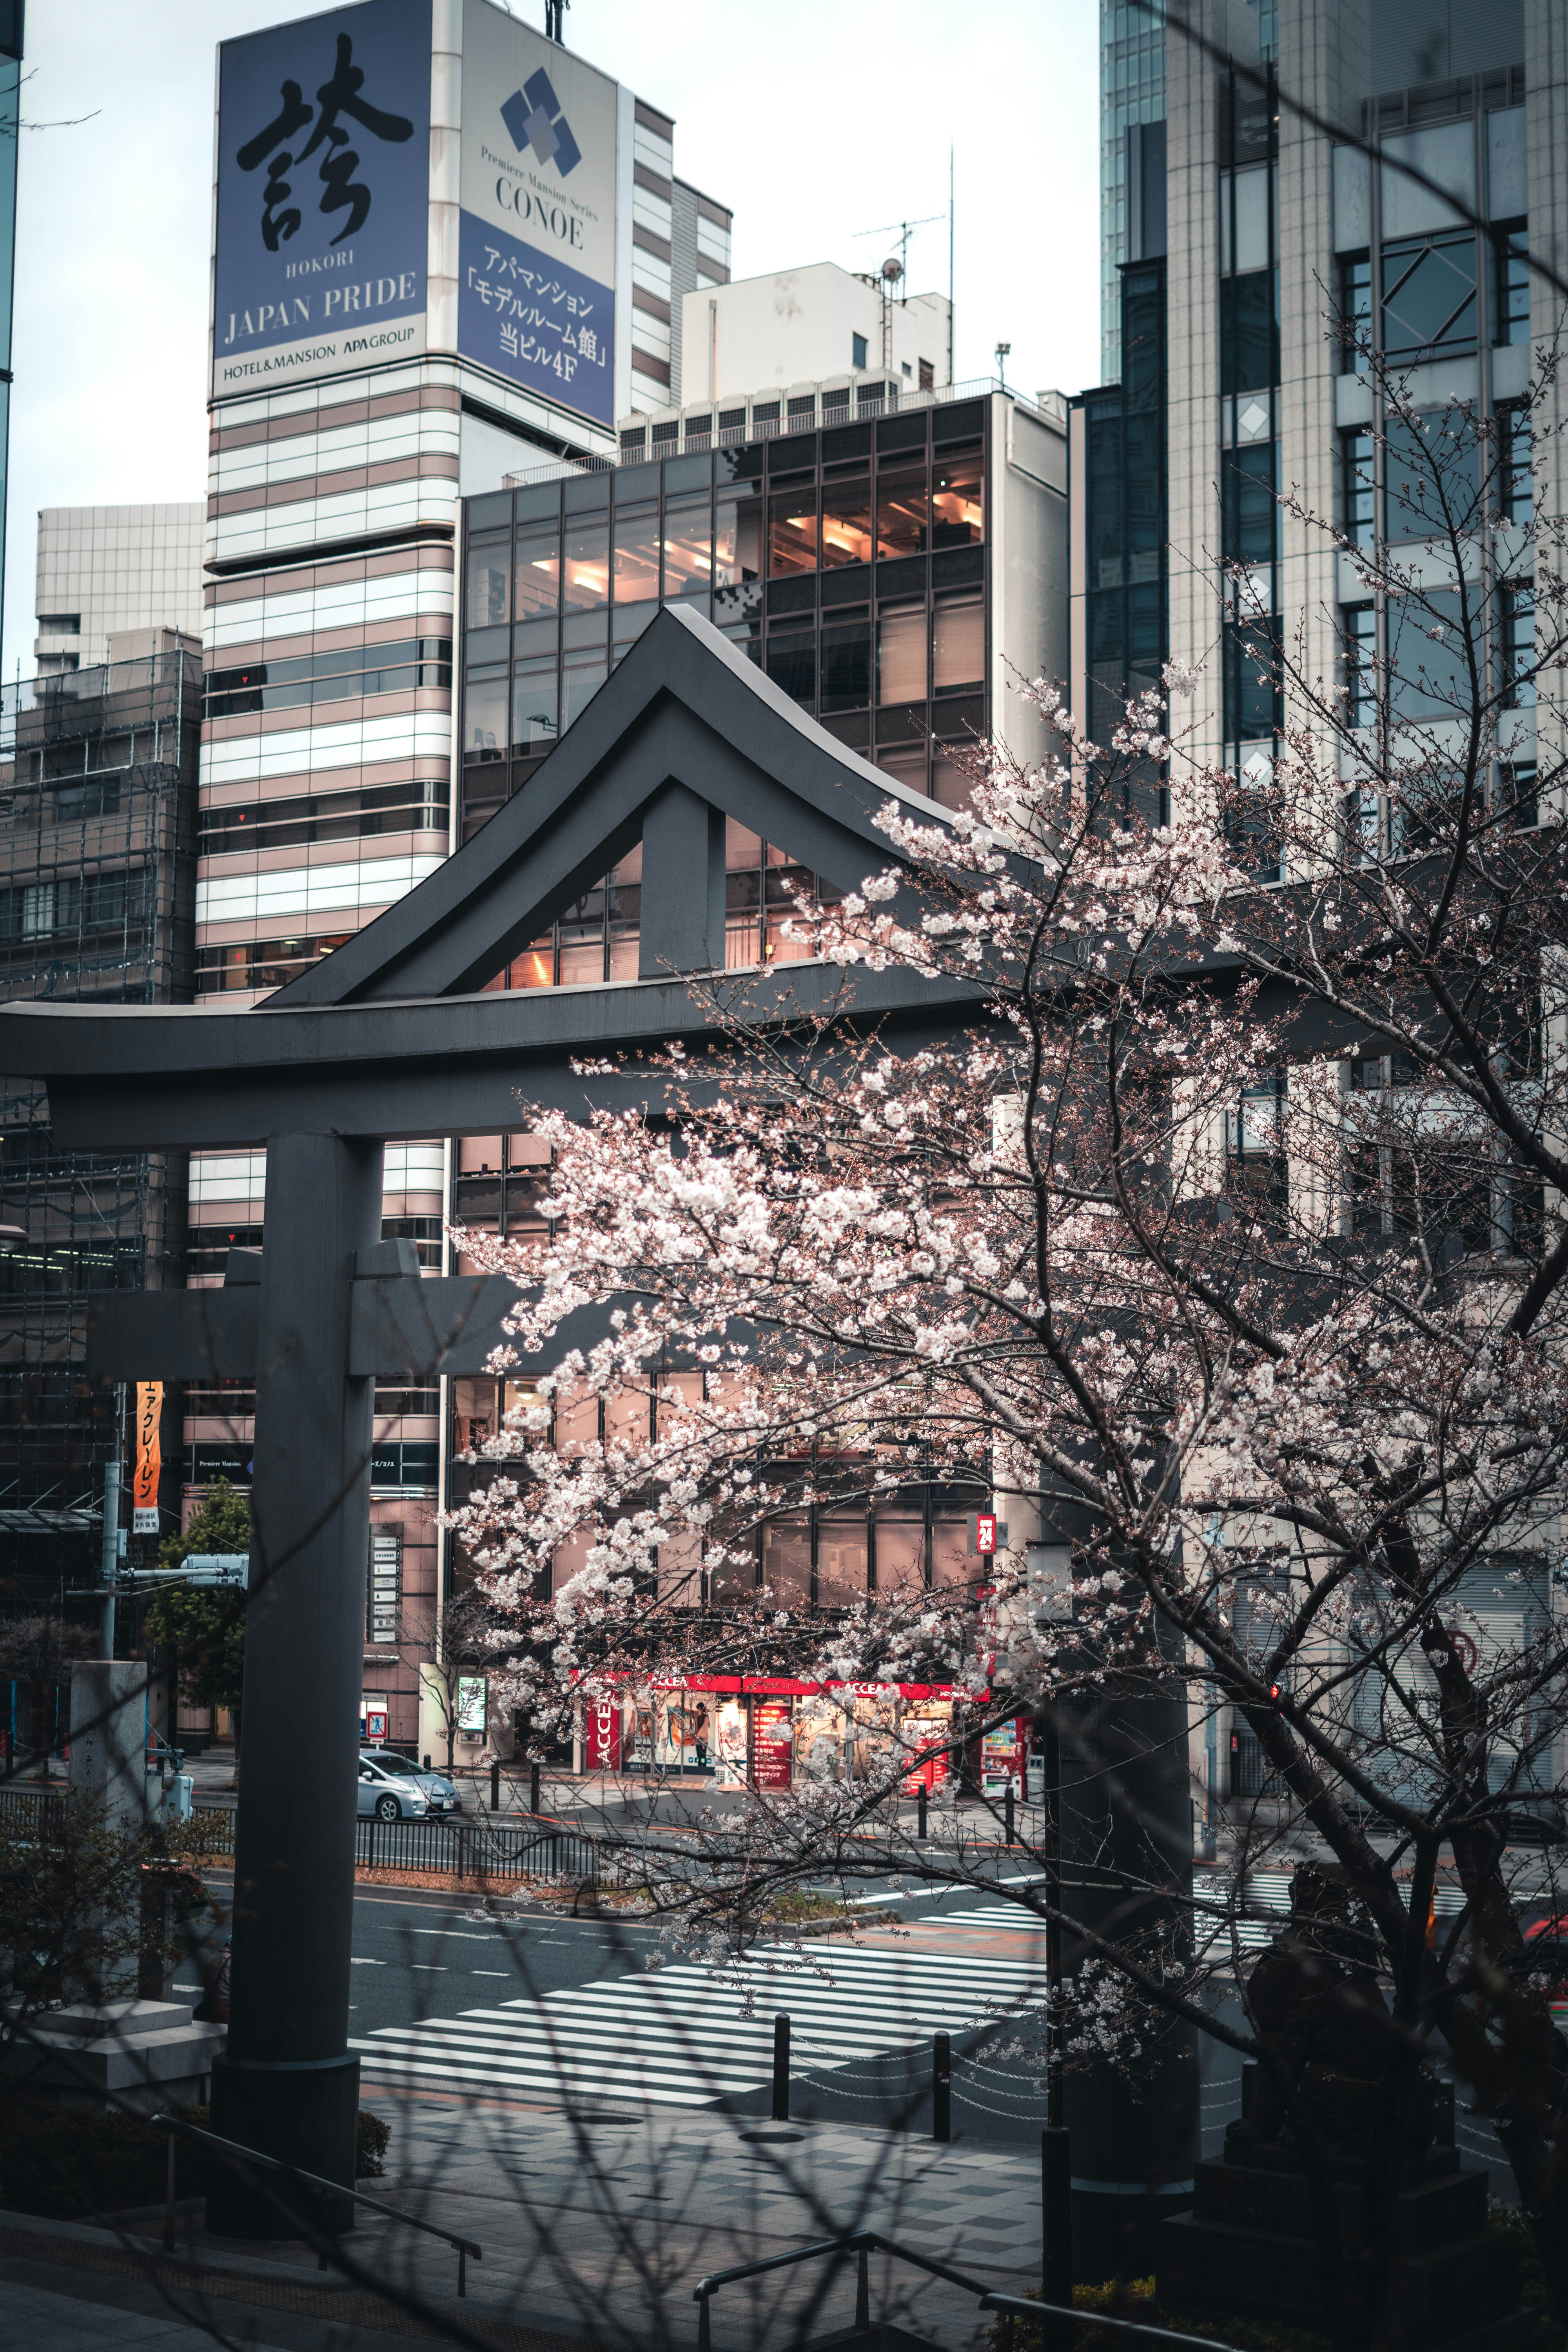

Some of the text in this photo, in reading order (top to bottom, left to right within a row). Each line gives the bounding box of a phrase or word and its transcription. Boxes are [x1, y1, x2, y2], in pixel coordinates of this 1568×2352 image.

[481, 145, 598, 222] Premiere Mansion Series
[496, 177, 583, 250] CONOE
[286, 250, 353, 279] HOKORI
[485, 245, 593, 318] アパマンション
[224, 272, 416, 345] JAPAN PRIDE
[469, 267, 605, 367] 「モデルルーム館」
[224, 344, 336, 380] HOTEL&MANSION
[500, 322, 577, 382] 当ビル4F
[979, 1527, 993, 1544] 24
